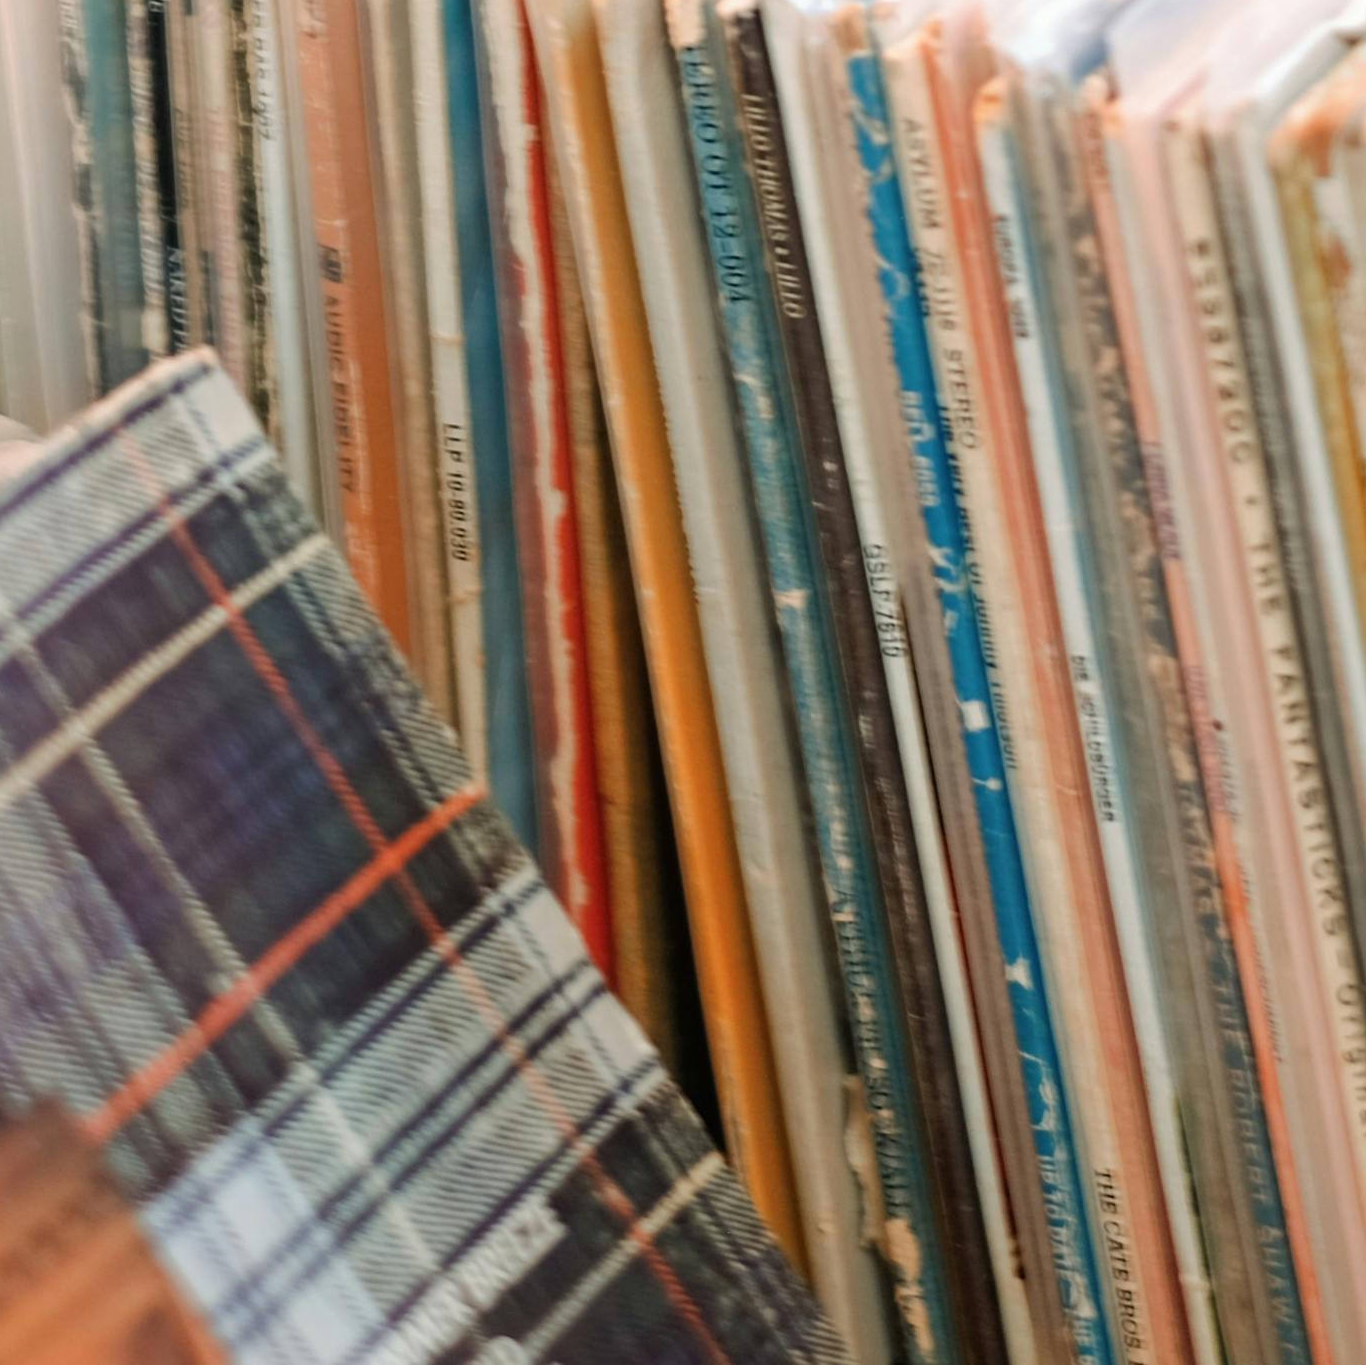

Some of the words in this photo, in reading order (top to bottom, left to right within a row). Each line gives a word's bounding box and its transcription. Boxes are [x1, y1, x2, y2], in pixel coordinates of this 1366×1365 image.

[756, 154, 791, 242] THOMAS
[713, 205, 750, 304] 12-004
[903, 115, 940, 232] ASYLUM
[944, 345, 979, 451] STEREO
[325, 294, 345, 365] AUDIO
[333, 380, 355, 493] FIDELITY
[444, 421, 466, 463] LLP
[1251, 538, 1283, 617] THE
[1274, 642, 1345, 941] FANTASTICKS
[1094, 1165, 1121, 1218] THE
[1228, 1062, 1272, 1206] ROBERT
[1260, 1221, 1298, 1327] SHAW
[1104, 1217, 1132, 1284] CATE
[1114, 1283, 1145, 1354] BROS.
